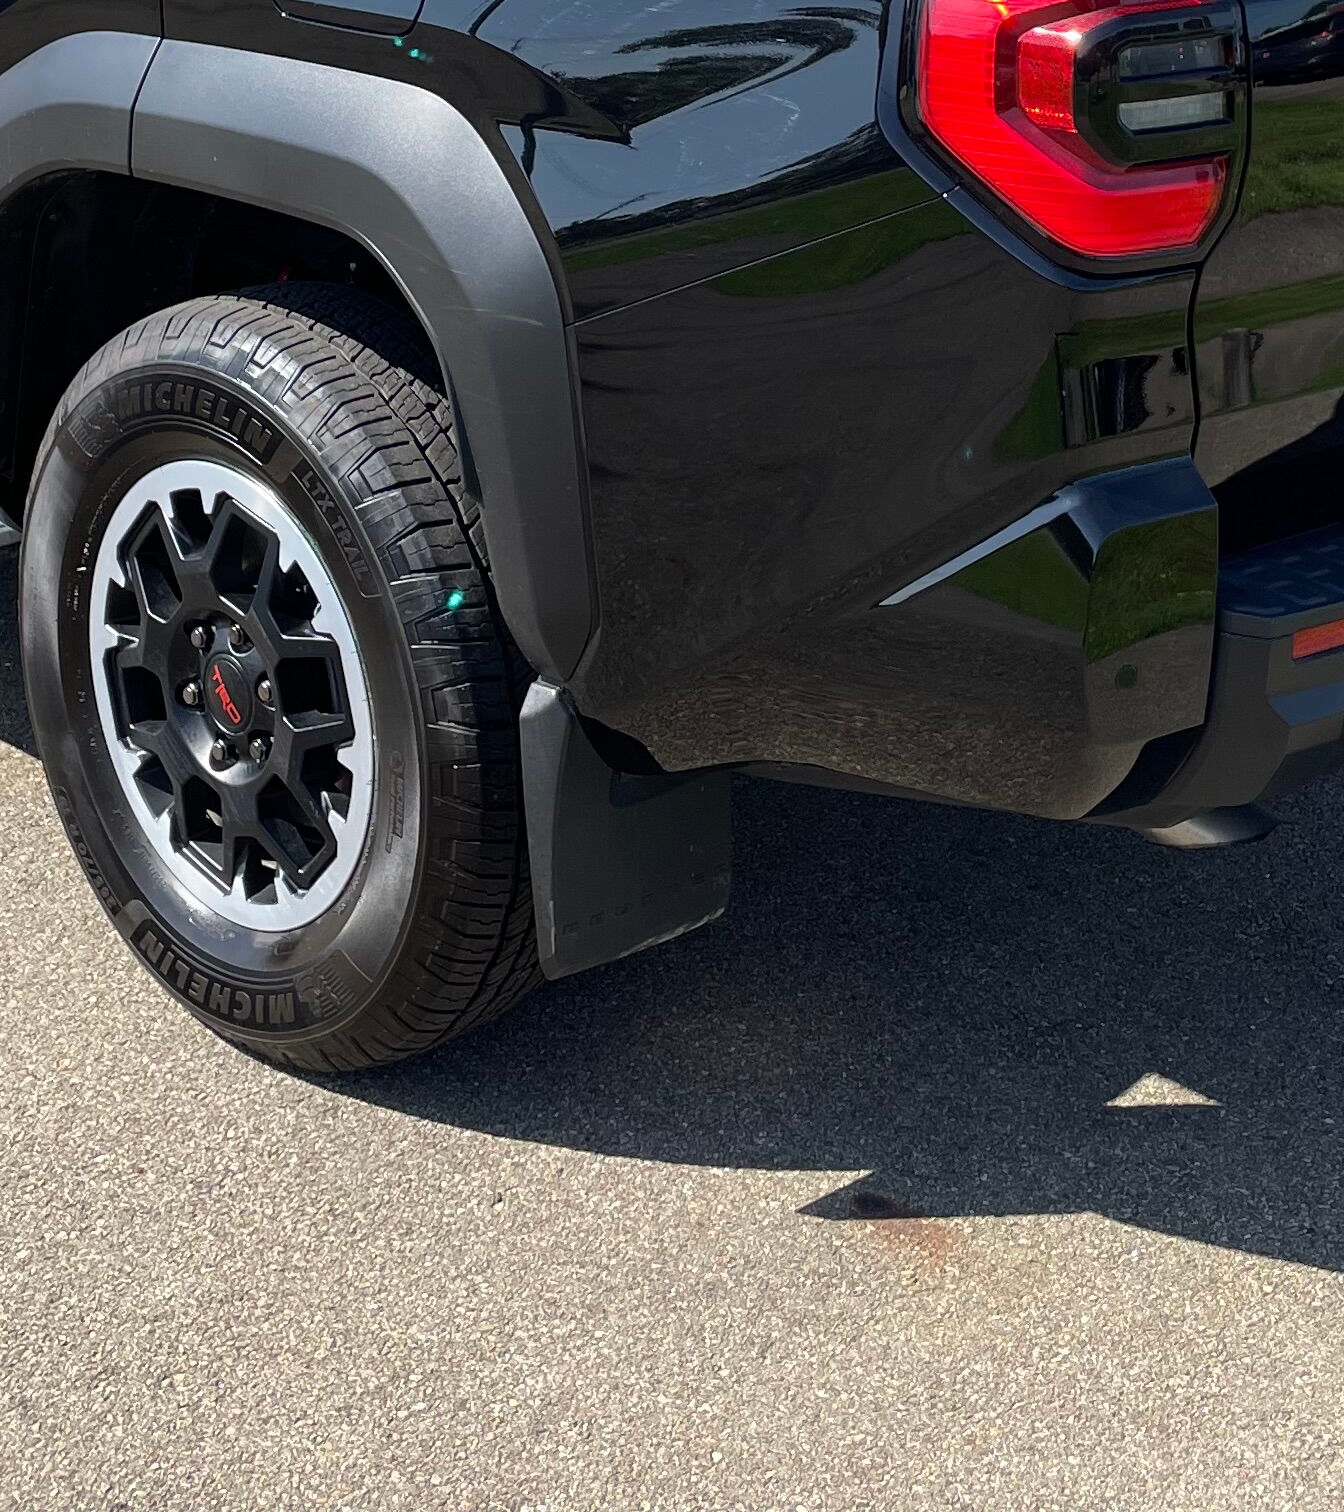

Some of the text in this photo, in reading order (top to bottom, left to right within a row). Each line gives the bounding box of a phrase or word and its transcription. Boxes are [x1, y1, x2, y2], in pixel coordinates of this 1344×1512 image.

[116, 382, 273, 454] MICHELIN
[301, 470, 370, 582] LTX TRAIL
[212, 664, 241, 725] TRD
[139, 929, 296, 1025] MICHELIN
